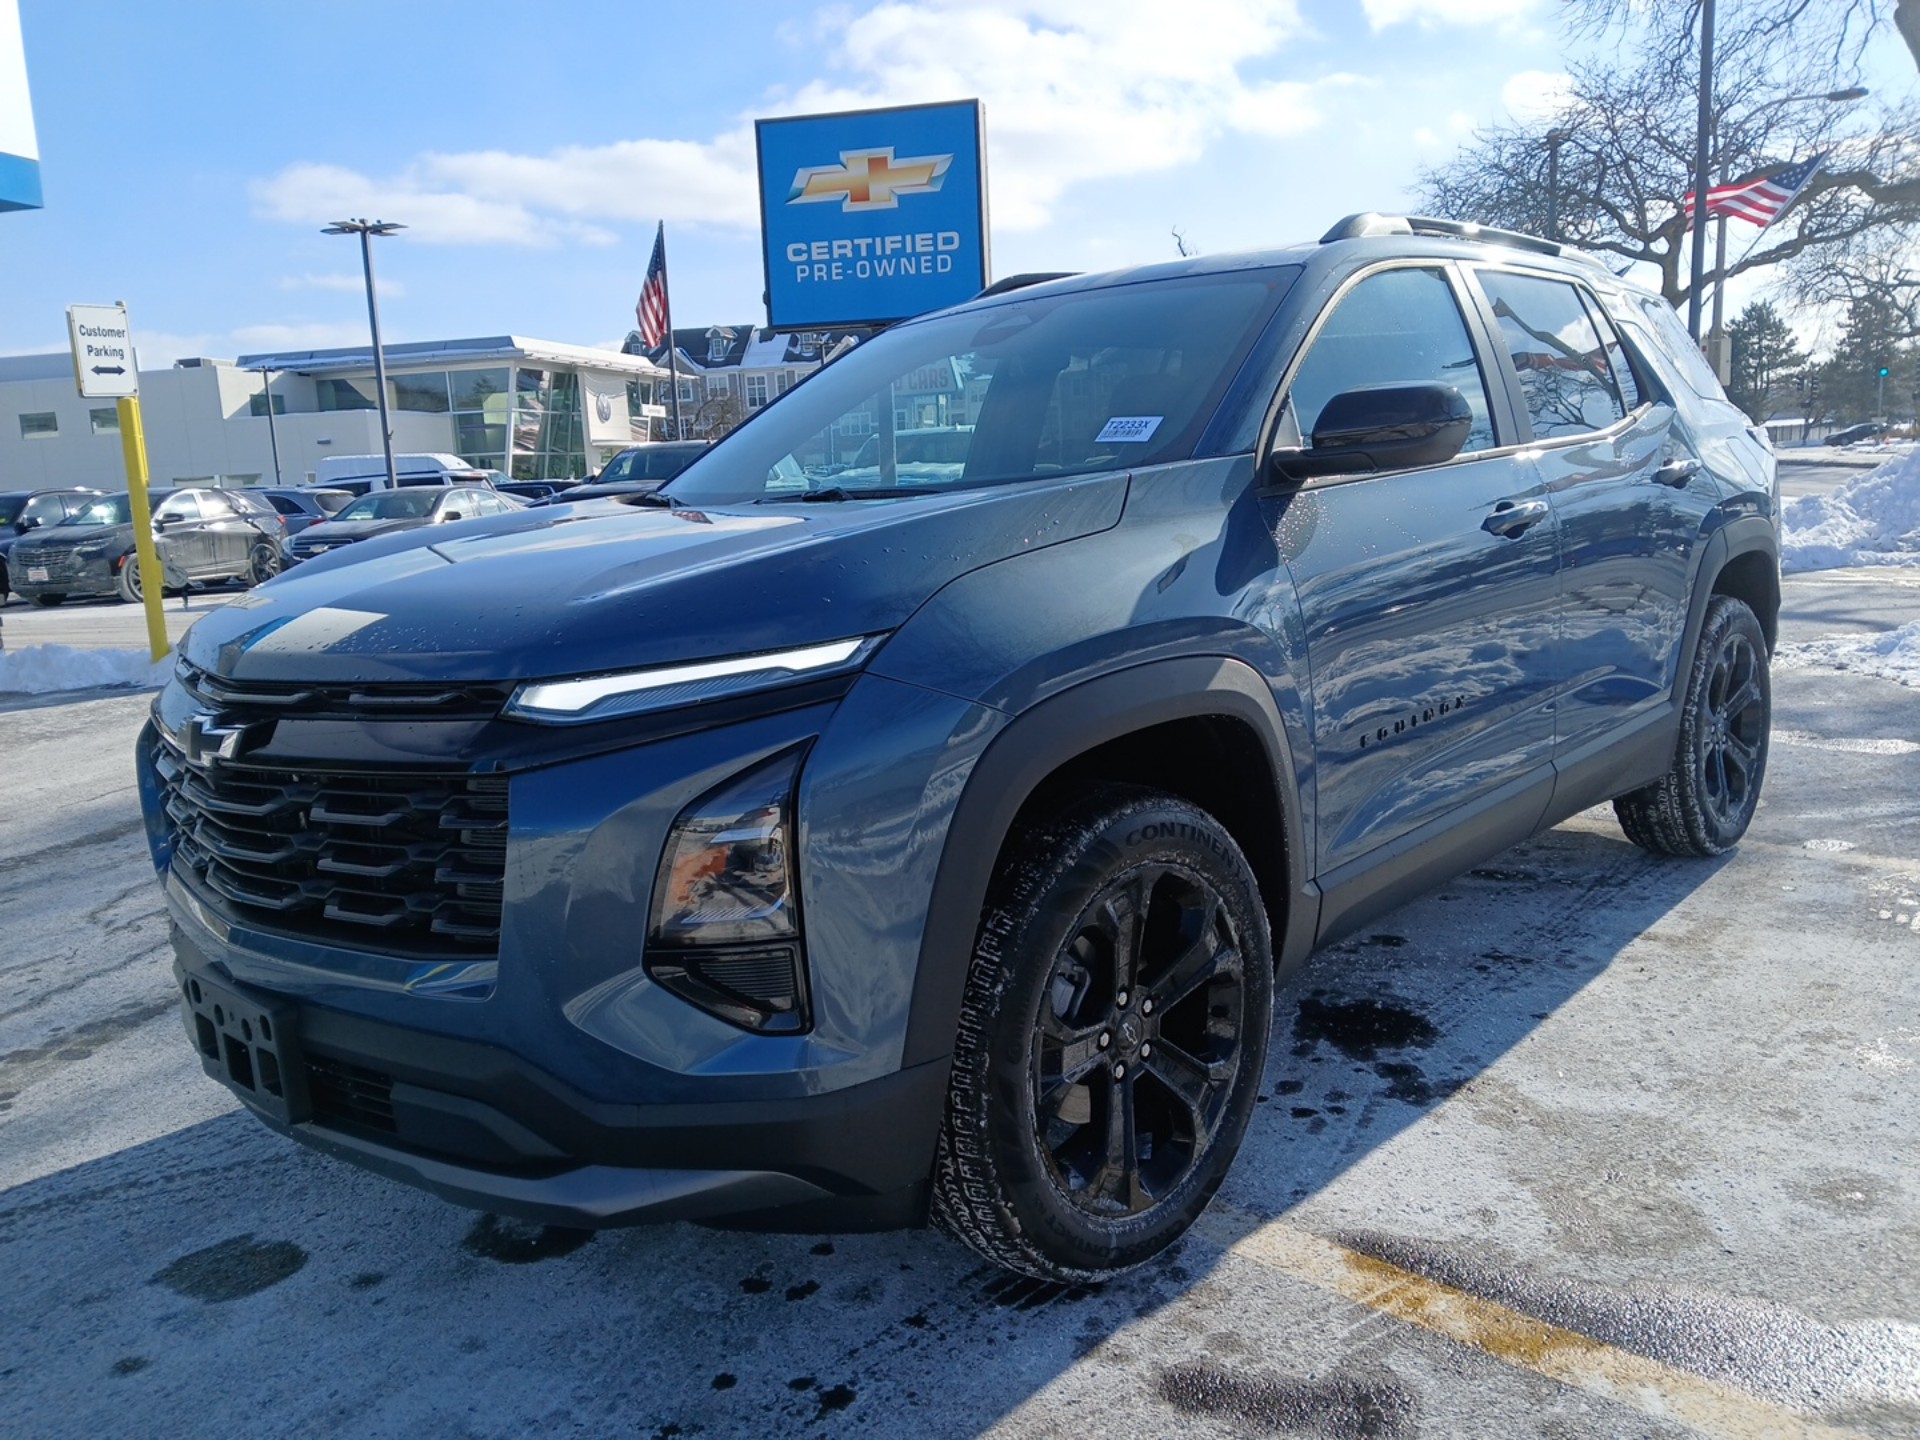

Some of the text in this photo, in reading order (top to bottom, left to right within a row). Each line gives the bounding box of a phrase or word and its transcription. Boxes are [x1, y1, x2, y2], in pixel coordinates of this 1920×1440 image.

[786, 231, 960, 262] CERTIFIED
[796, 254, 952, 283] PRE-OWNED
[78, 324, 125, 338] Customer
[86, 344, 125, 360] Parking
[908, 367, 949, 390] CARS
[1359, 694, 1465, 749] EQUINOX
